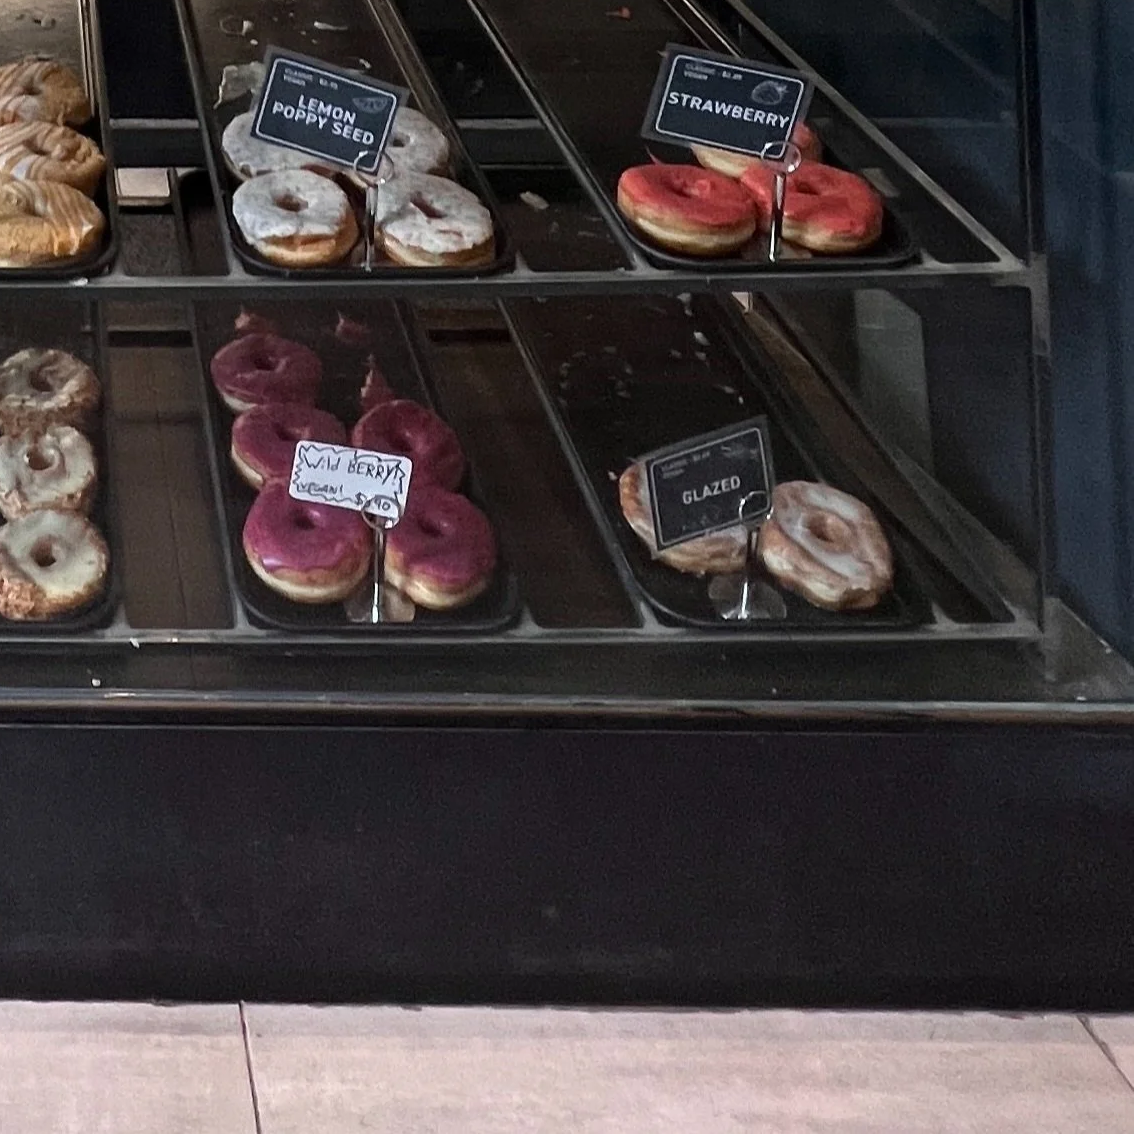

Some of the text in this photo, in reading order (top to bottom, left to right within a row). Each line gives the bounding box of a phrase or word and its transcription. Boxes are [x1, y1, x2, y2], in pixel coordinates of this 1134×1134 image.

[272, 100, 374, 145] POPPY SEED
[298, 94, 356, 125] LEMON
[668, 91, 789, 129] STRAWBERRY
[682, 475, 741, 505] GLAZED
